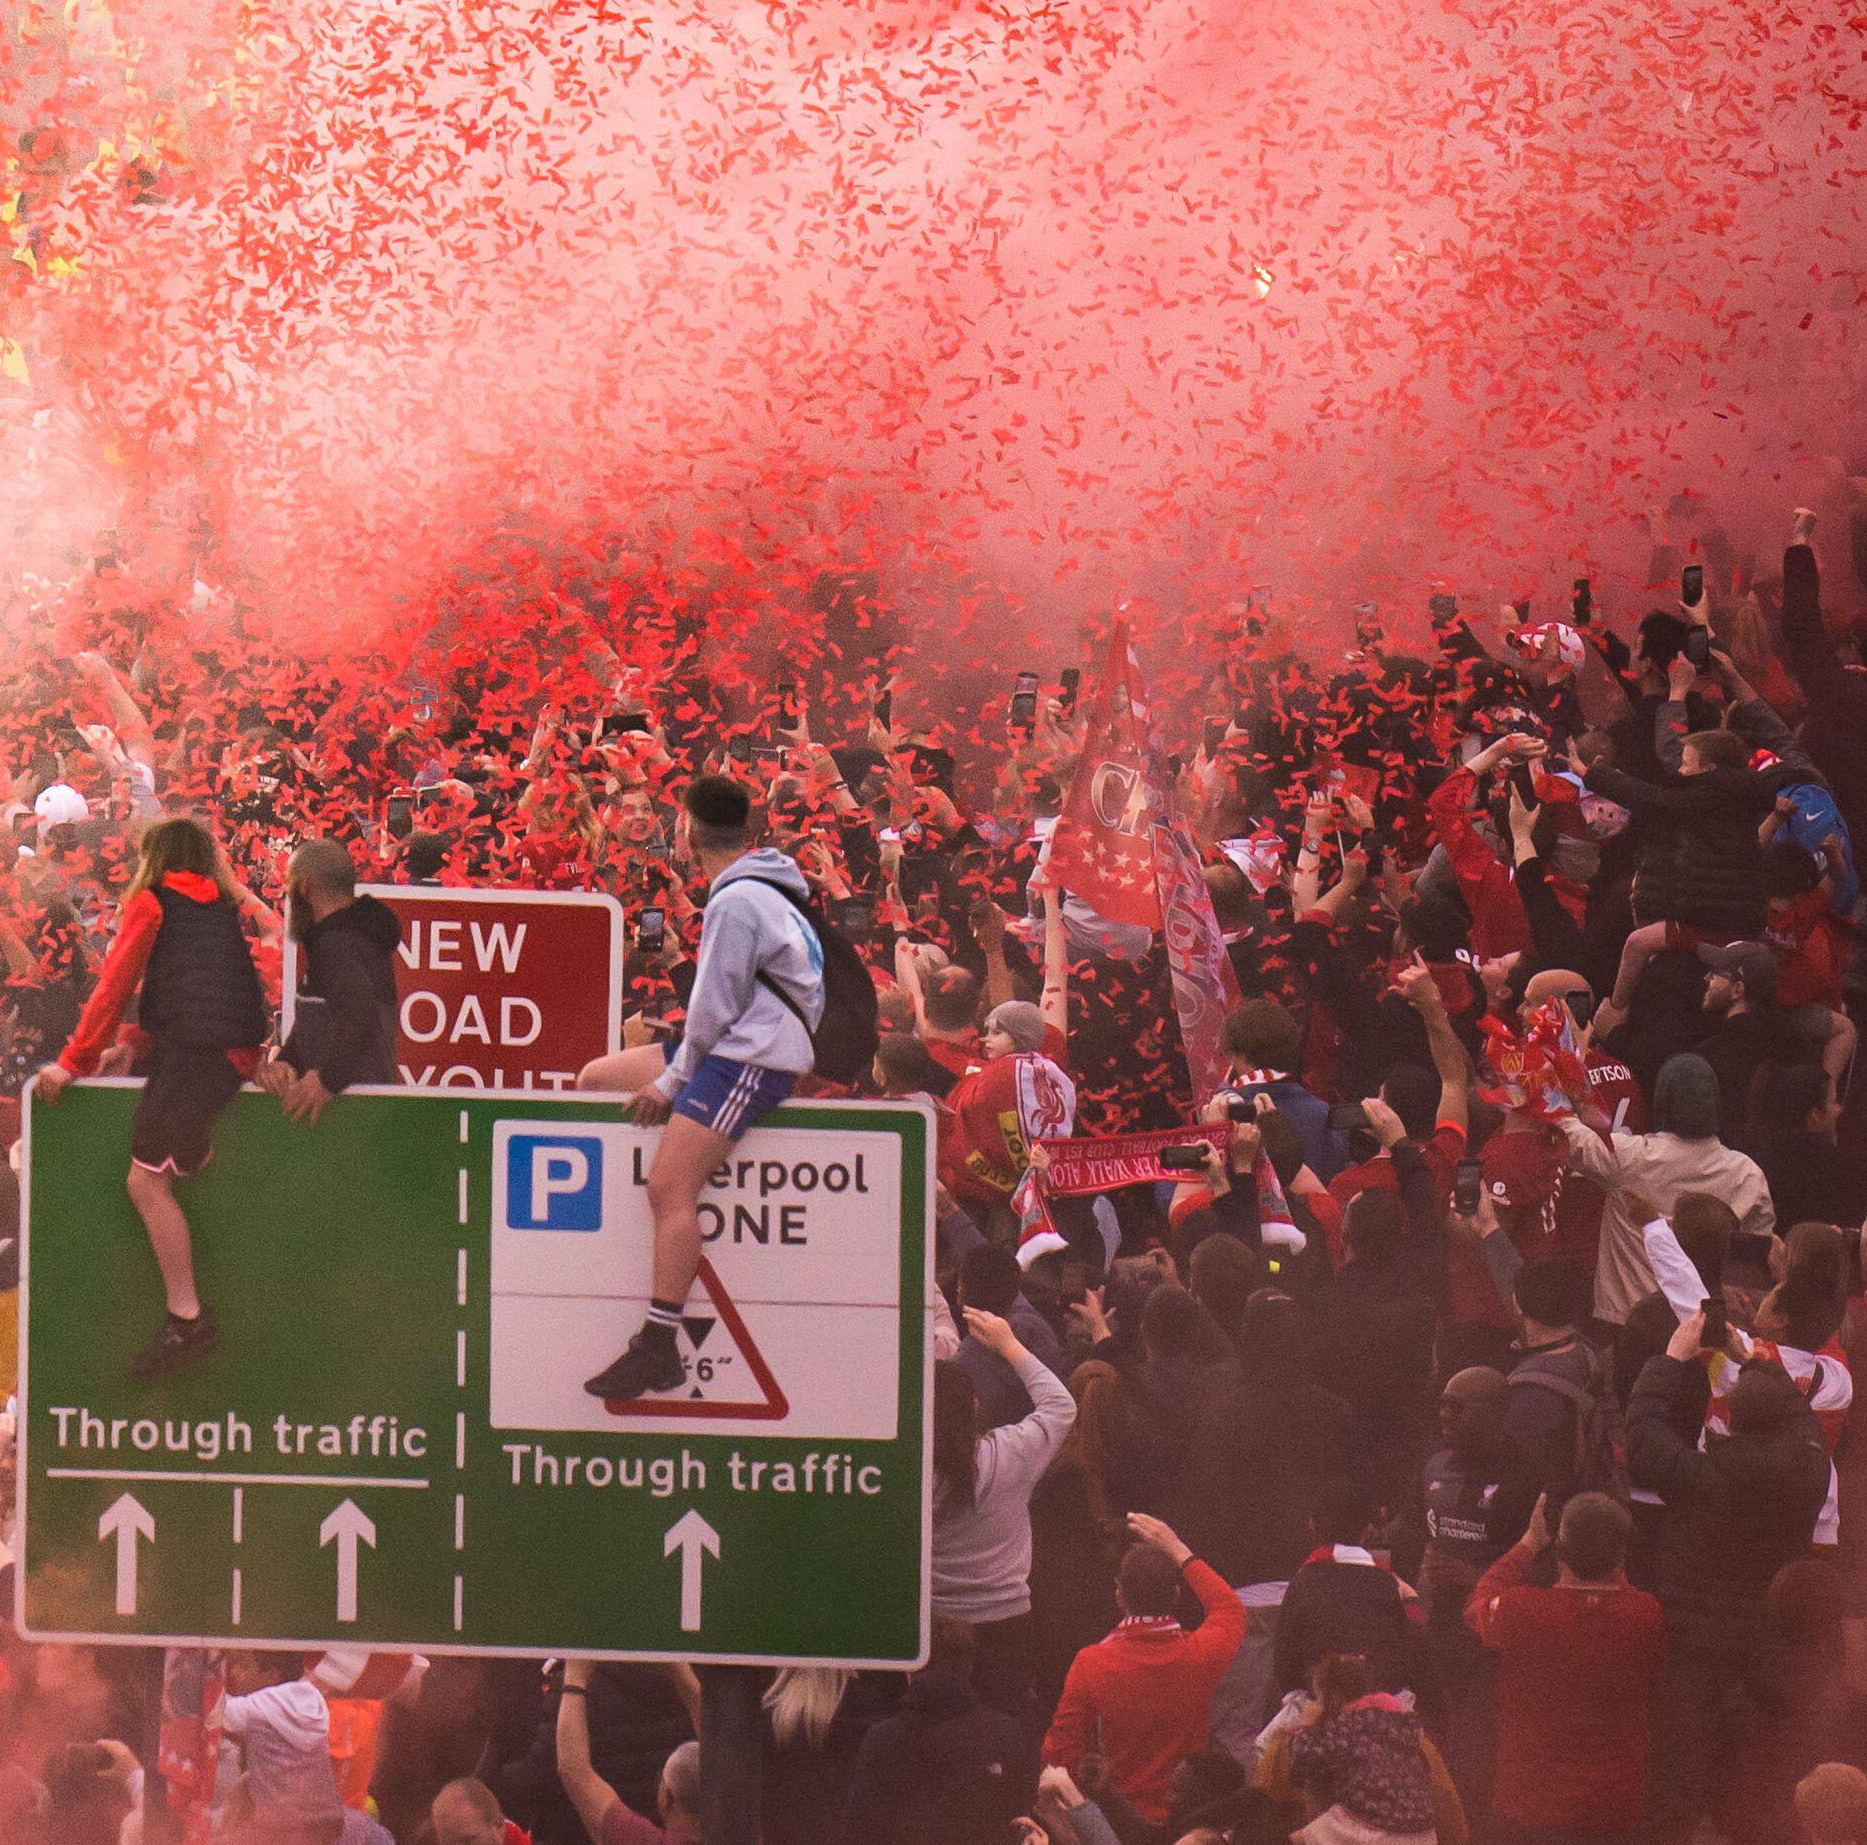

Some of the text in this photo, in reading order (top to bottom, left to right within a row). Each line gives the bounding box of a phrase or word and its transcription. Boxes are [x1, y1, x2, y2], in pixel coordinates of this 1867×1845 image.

[398, 922, 527, 974] NEW
[399, 991, 545, 1045] OAD
[531, 1144, 589, 1221] P
[633, 1146, 869, 1197] Lerpool
[697, 1202, 808, 1246] ONE
[50, 1407, 428, 1460] Through traffic
[502, 1444, 883, 1496] Through traffic
